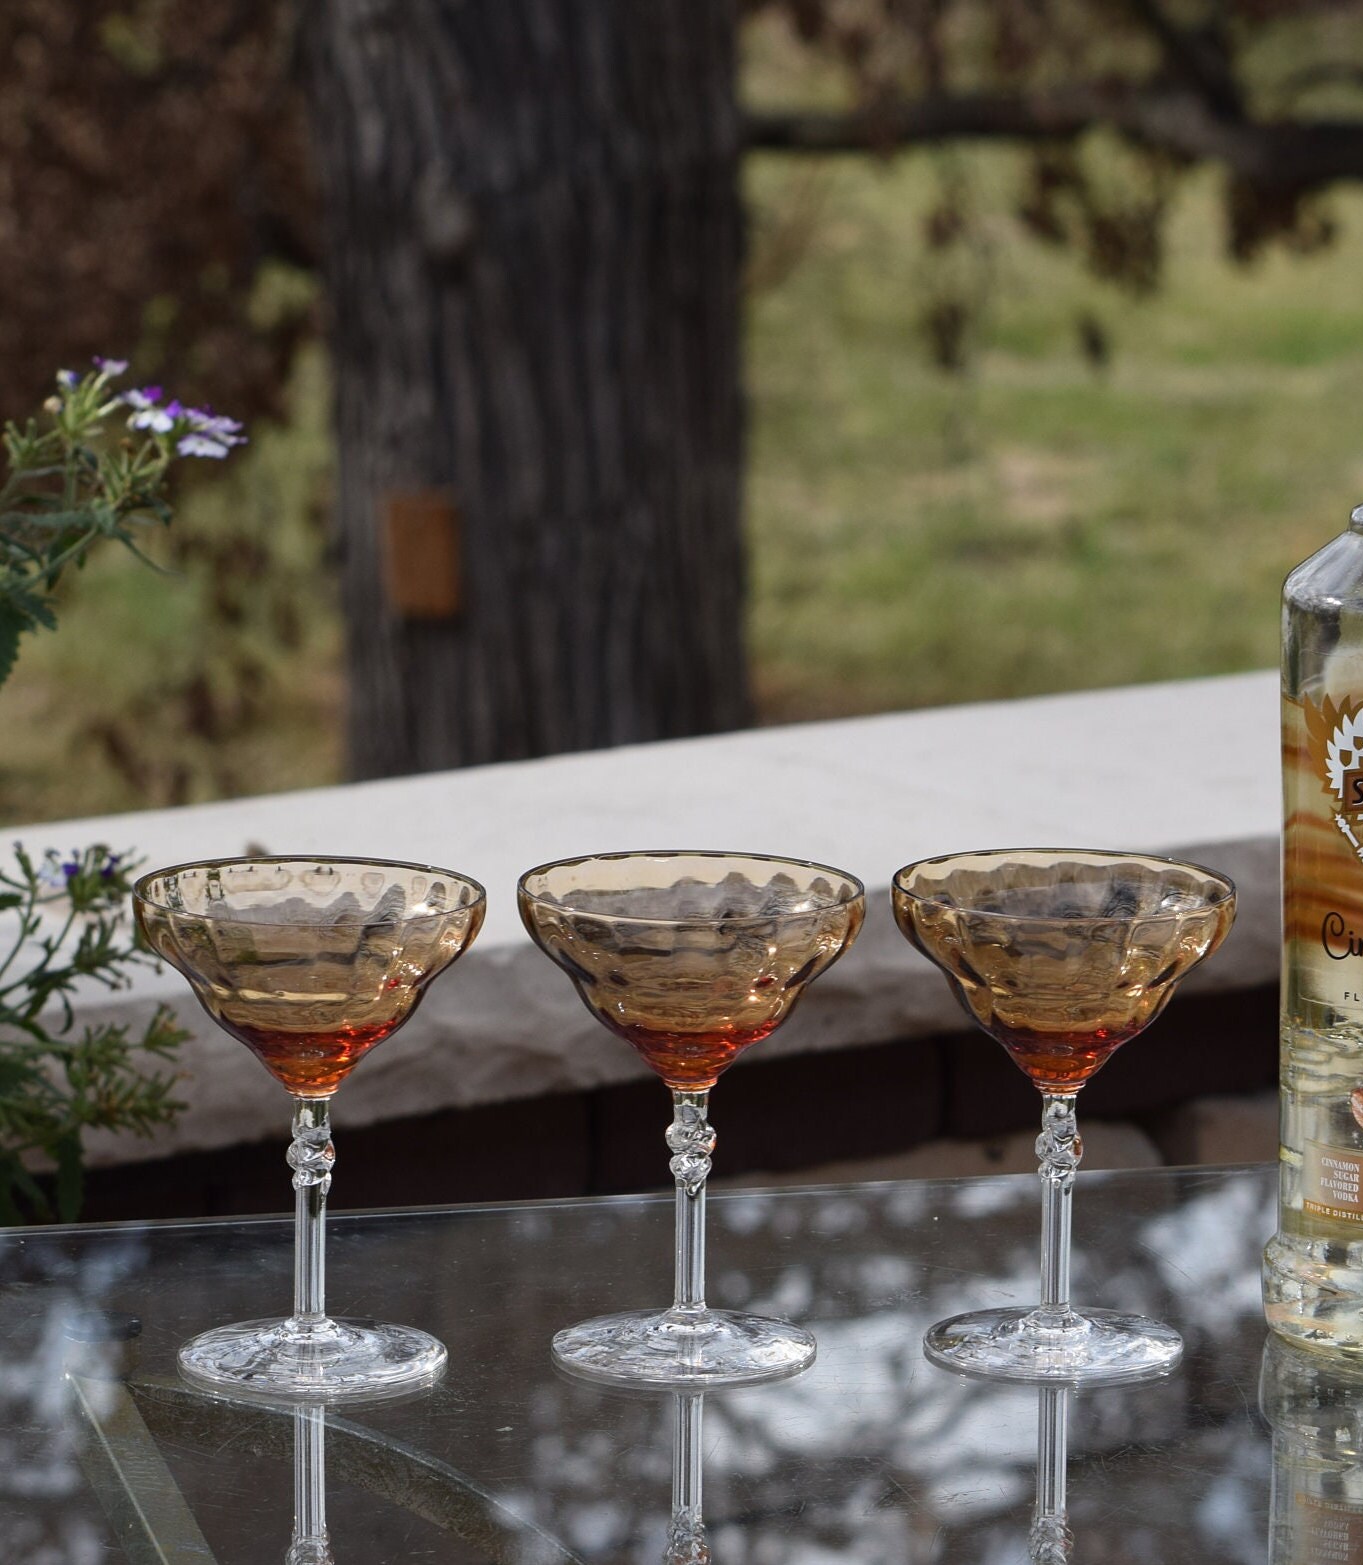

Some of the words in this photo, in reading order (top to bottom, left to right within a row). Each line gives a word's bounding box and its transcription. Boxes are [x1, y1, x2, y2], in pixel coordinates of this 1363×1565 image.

[1321, 1157, 1360, 1173] CINNAMON
[1333, 1170, 1360, 1183] SUGAR
[1320, 1176, 1359, 1192] FLAVORED
[1332, 1190, 1360, 1203] VODKA
[1305, 1201, 1331, 1215] TRIPLE
